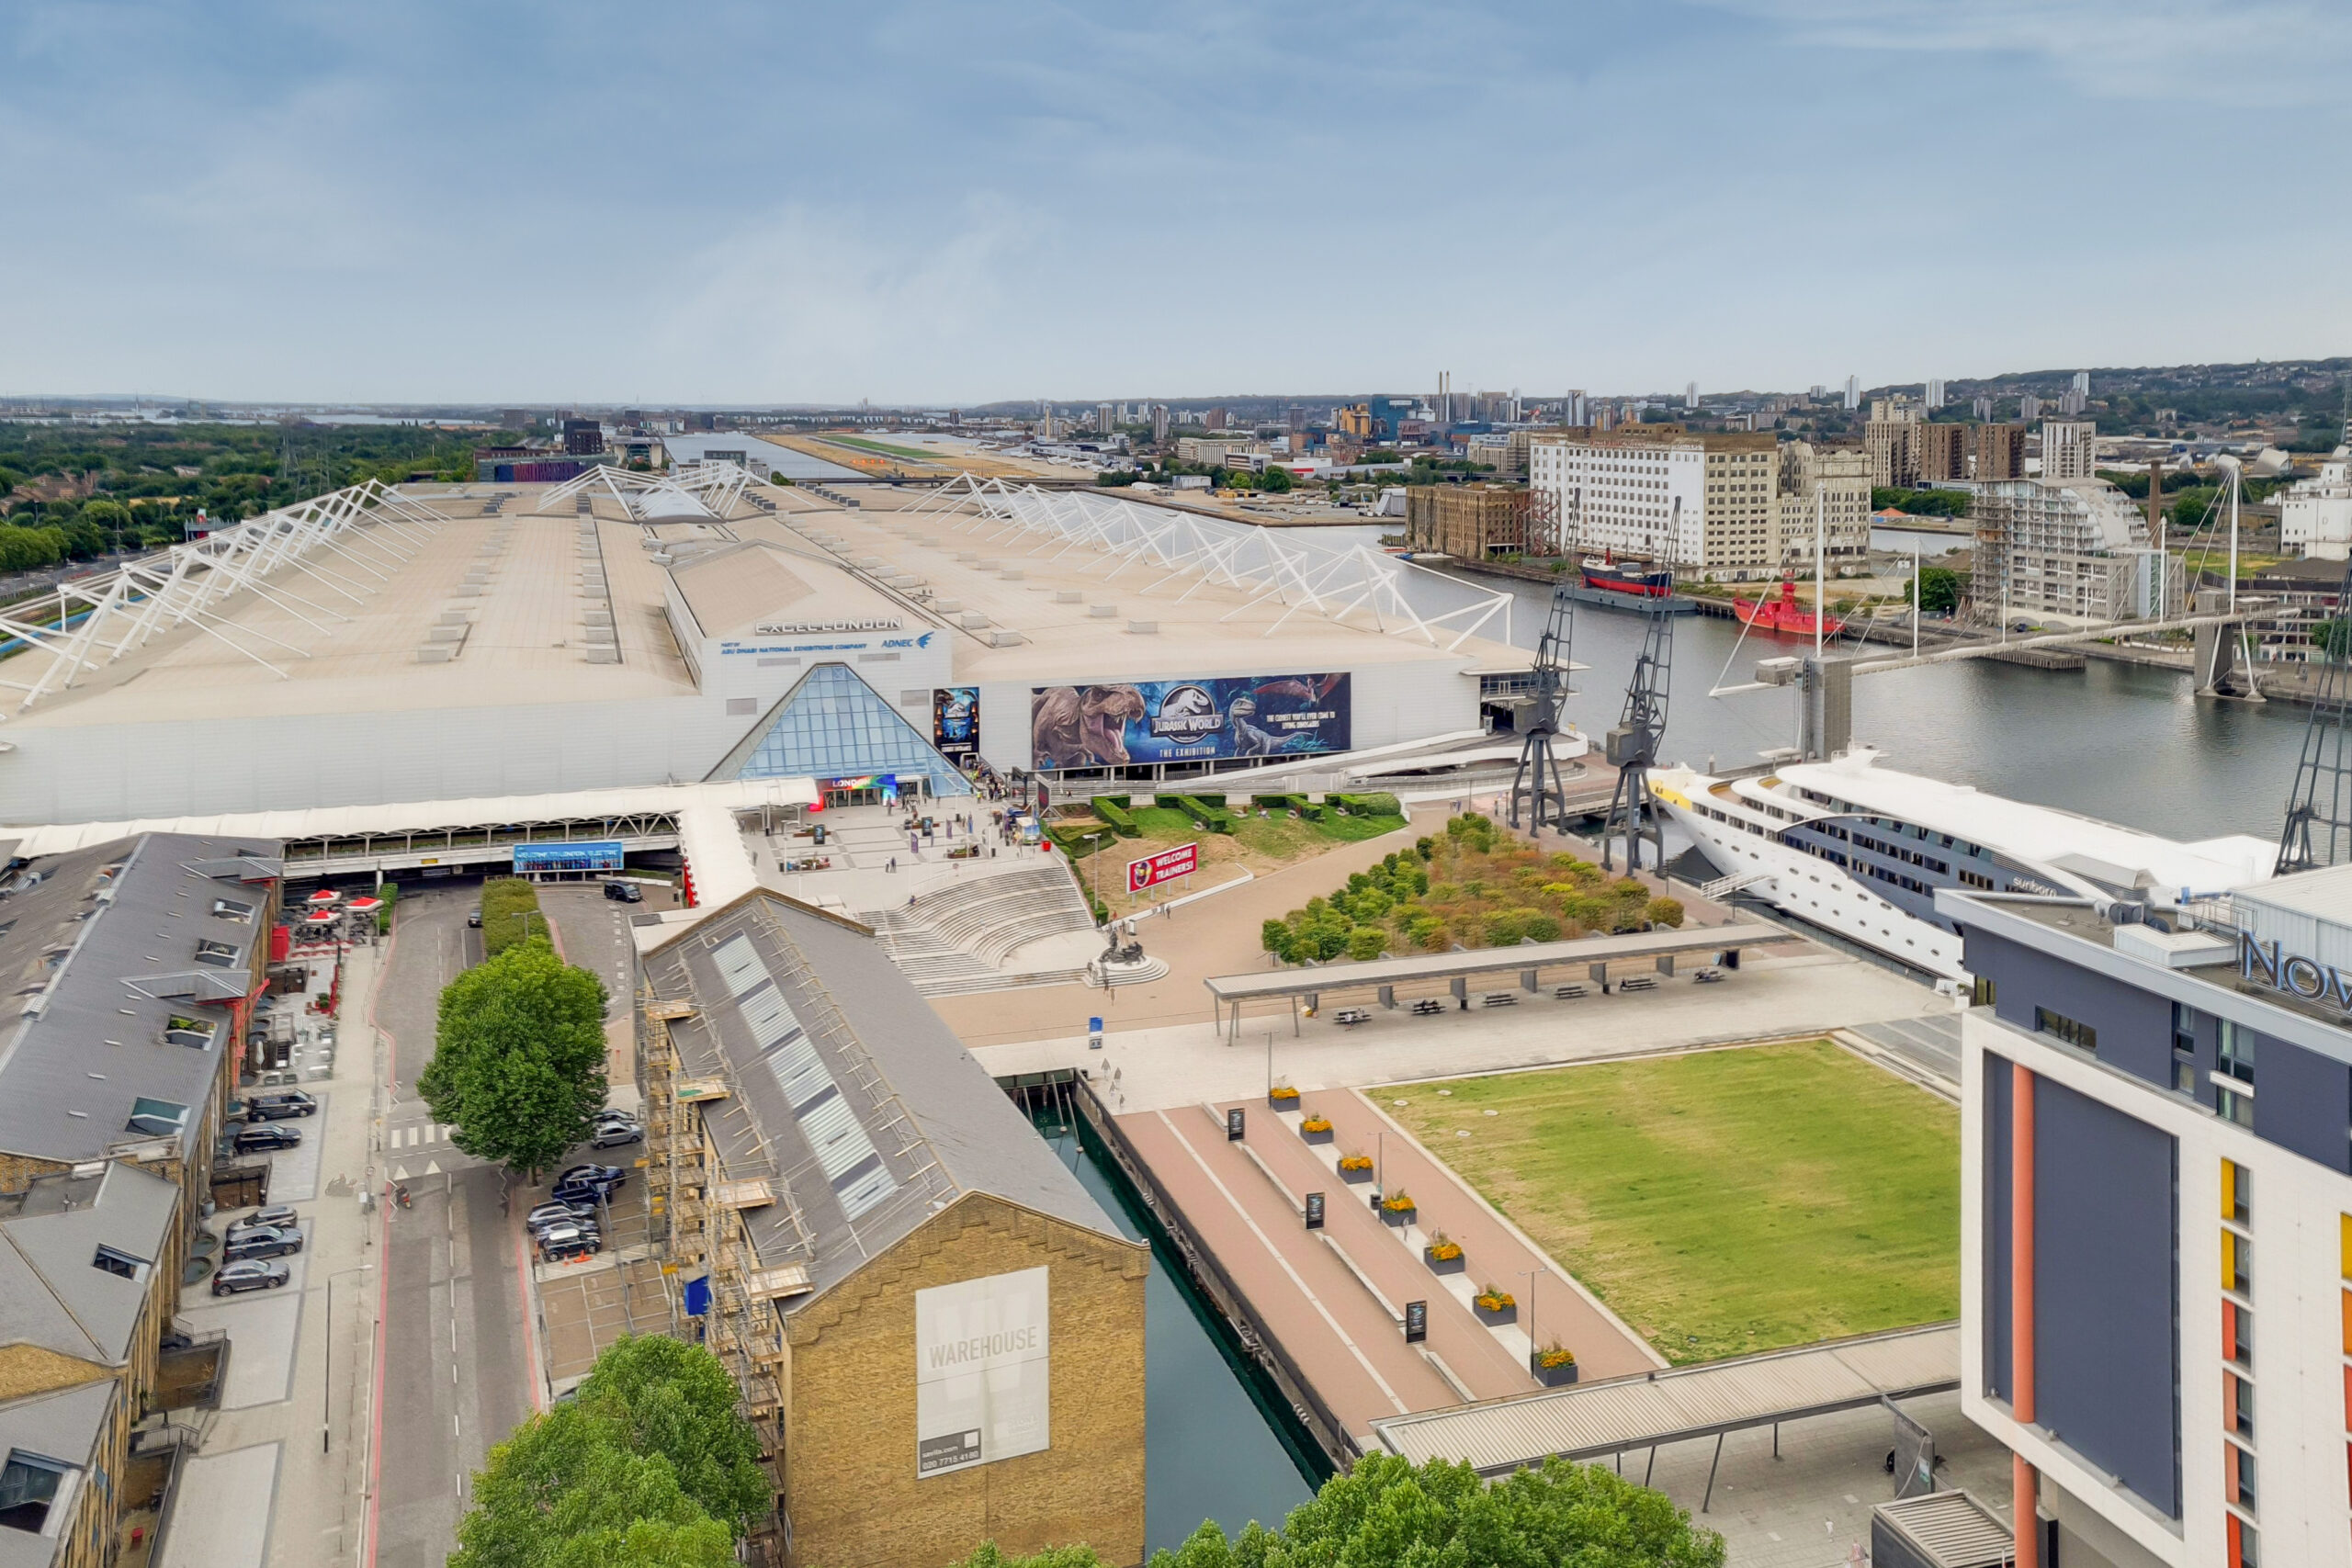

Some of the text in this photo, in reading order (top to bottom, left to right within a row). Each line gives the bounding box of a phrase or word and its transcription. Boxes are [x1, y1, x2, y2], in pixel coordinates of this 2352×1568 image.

[756, 616, 901, 633] EXCEL LONDON
[882, 638, 914, 648] ADNEC
[1154, 717, 1221, 733] JURASSIC WORLD
[1159, 746, 1216, 757] THE EXHIBITION
[1156, 849, 1193, 867] WELCOME
[1156, 860, 1194, 880] TRAINERS!
[2013, 876, 2057, 897] sunborn
[930, 1325, 1037, 1369] WAREHOUSE
[922, 1446, 958, 1459] savills.com
[922, 1460, 938, 1470] 020
